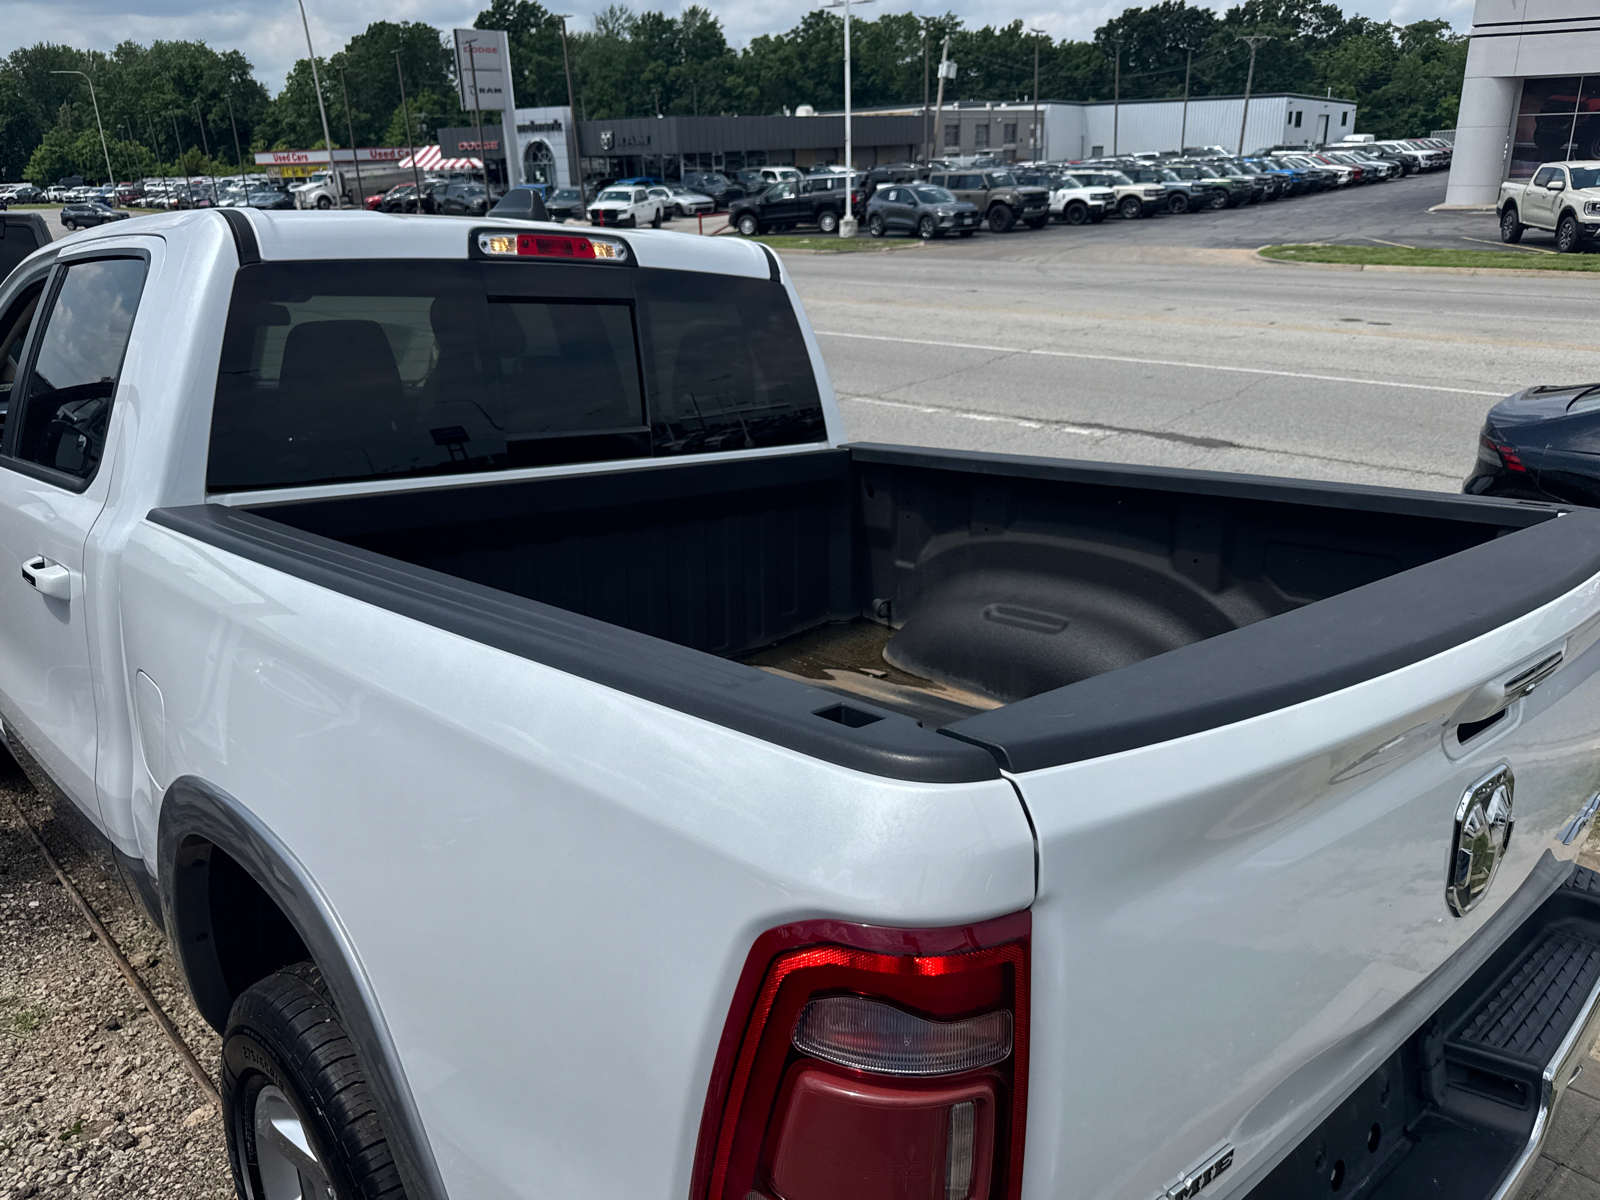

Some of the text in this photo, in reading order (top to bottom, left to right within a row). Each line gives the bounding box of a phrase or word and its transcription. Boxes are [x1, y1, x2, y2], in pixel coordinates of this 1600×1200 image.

[463, 46, 498, 54] DODGE
[479, 87, 502, 95] RAM
[458, 141, 499, 150] DODGE
[617, 135, 651, 147] RAM
[273, 152, 309, 162] Used Cars
[370, 149, 395, 159] Used
